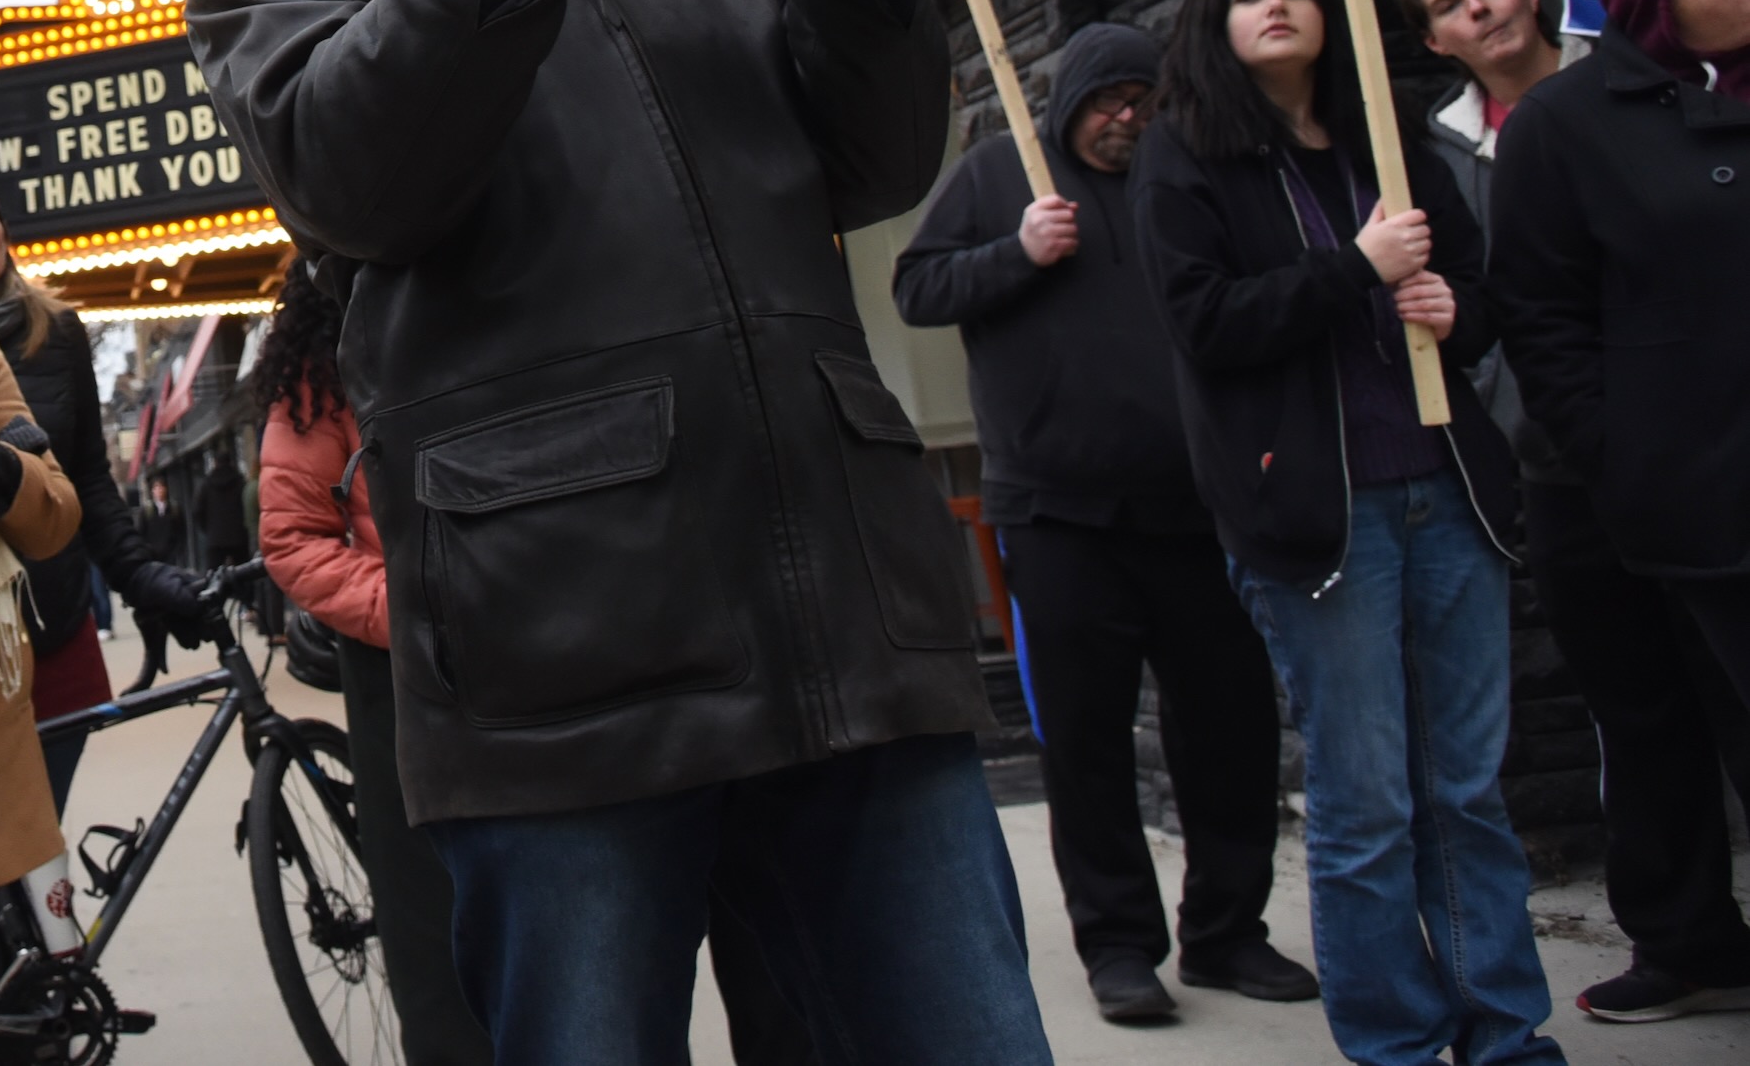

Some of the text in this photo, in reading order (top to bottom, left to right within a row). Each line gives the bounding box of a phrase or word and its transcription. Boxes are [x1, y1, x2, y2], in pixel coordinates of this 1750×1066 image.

[46, 67, 167, 122] SPEND
[56, 115, 151, 164] FREE
[18, 145, 243, 214] THANK YOU
